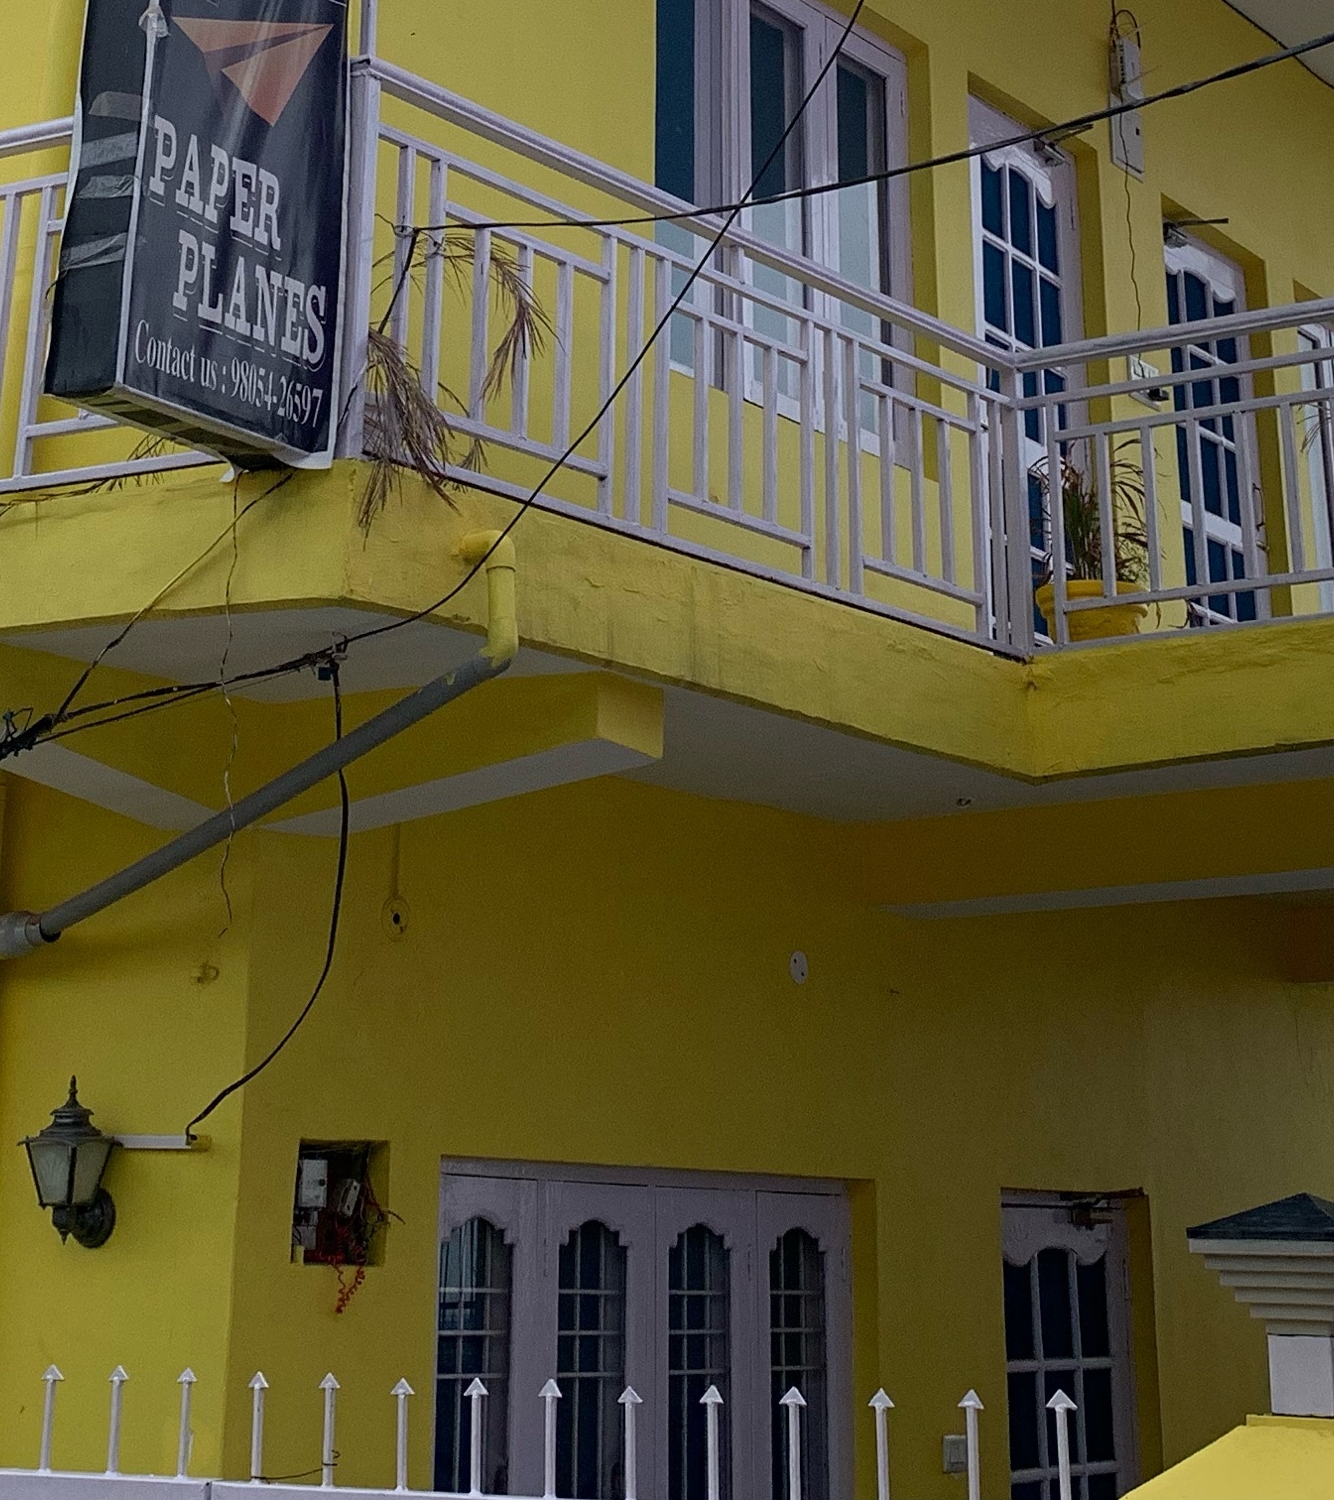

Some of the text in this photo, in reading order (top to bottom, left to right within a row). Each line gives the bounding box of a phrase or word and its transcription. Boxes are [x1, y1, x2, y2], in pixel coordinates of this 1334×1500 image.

[149, 114, 282, 255] PAPER
[134, 319, 196, 383] Contact
[172, 230, 327, 371] PLANES
